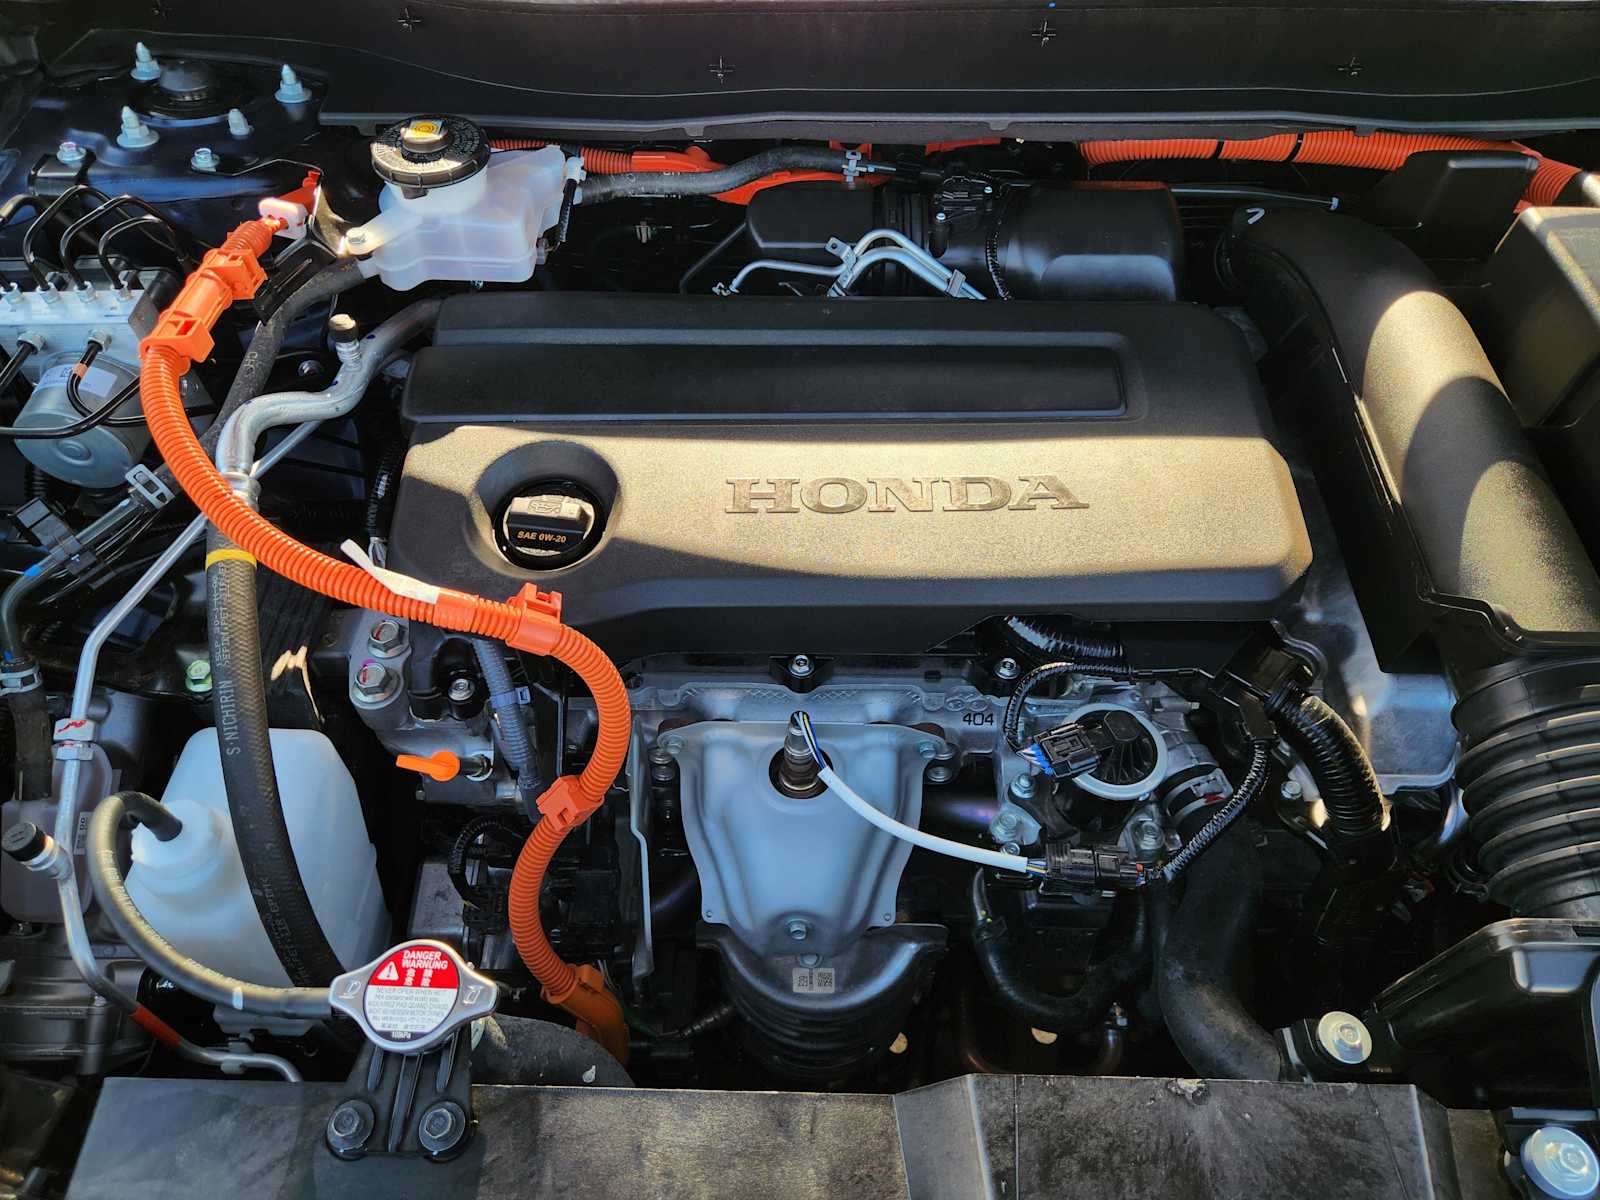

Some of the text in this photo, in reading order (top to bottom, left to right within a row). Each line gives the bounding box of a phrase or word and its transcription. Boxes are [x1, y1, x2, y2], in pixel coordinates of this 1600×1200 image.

[725, 475, 1090, 514] HONDA
[517, 531, 567, 543] SAE 0W-20
[962, 713, 994, 726] 404
[403, 950, 442, 960] DANGER
[401, 959, 448, 970] WARNUNG
